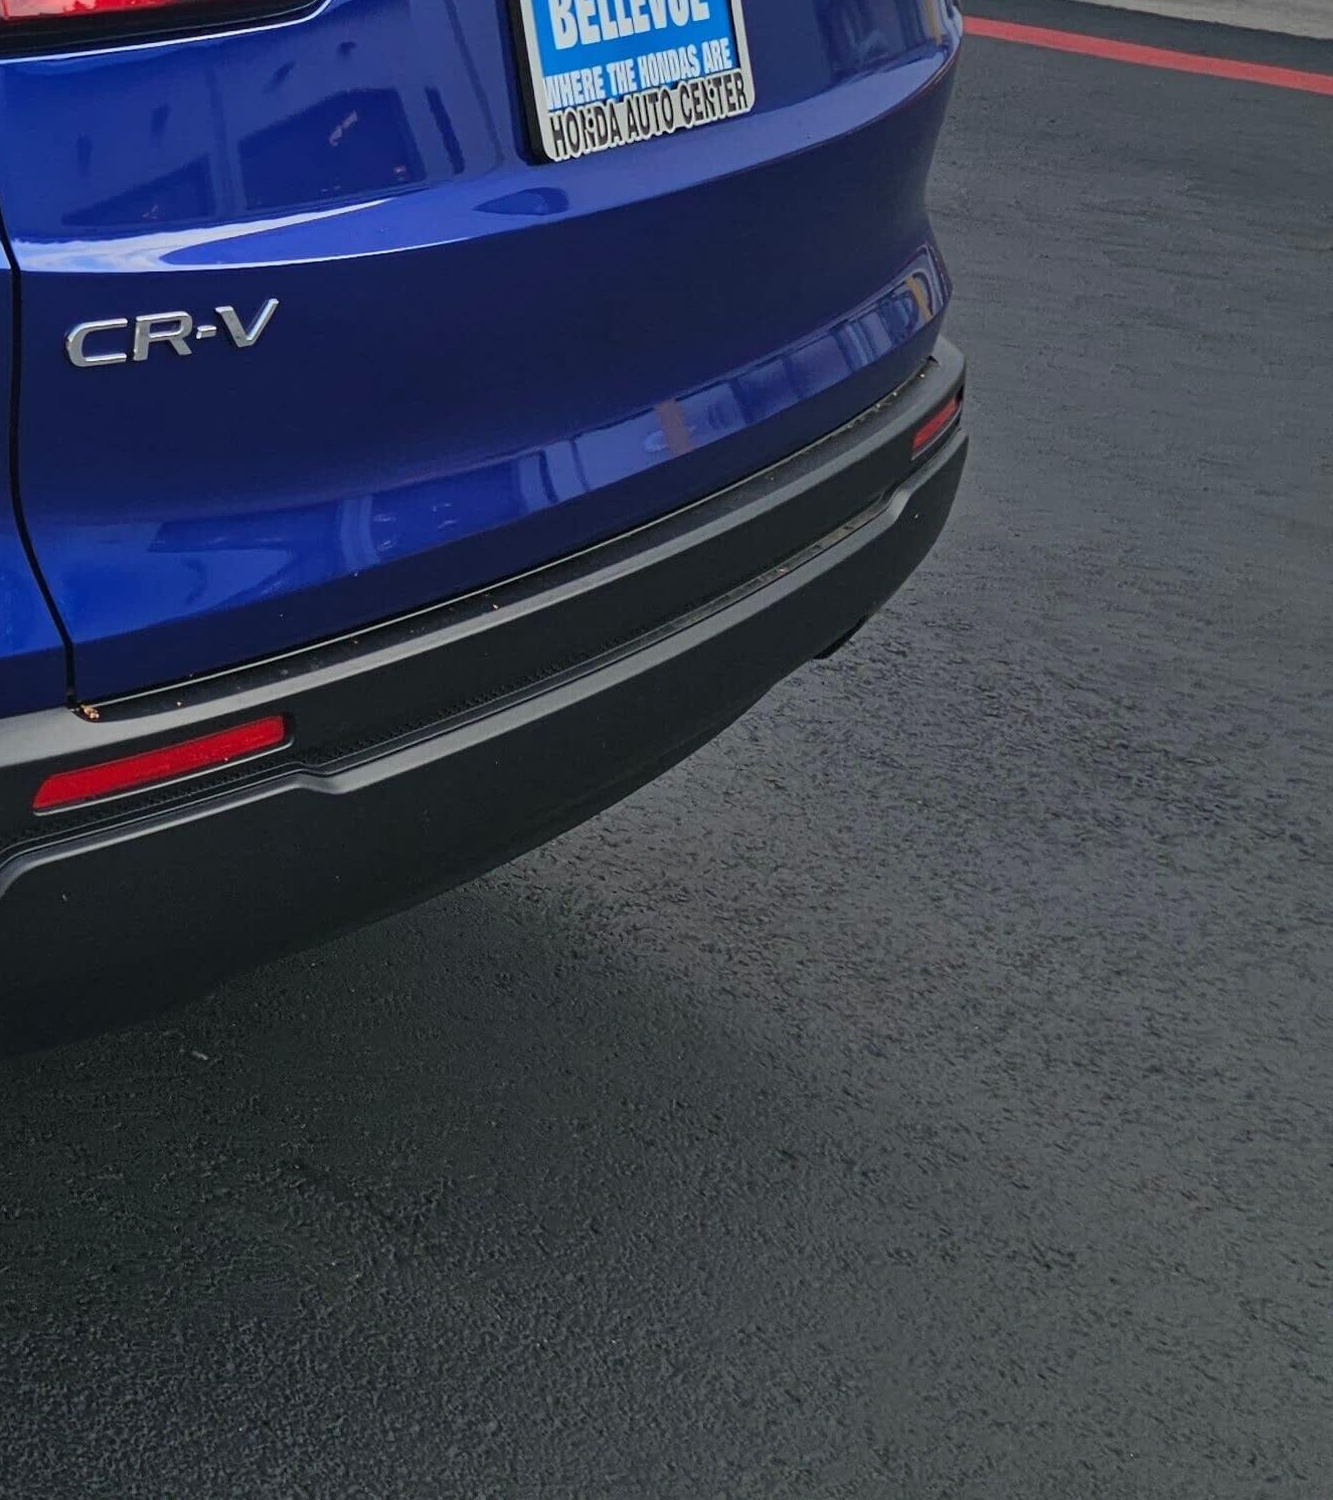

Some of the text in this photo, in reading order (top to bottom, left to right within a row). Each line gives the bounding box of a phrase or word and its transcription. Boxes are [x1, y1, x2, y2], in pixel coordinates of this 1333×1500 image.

[541, 37, 734, 111] WHERE THE HONDAS ARE
[549, 71, 749, 158] HONDA AUTO CENTER
[65, 297, 280, 367] CR-V
